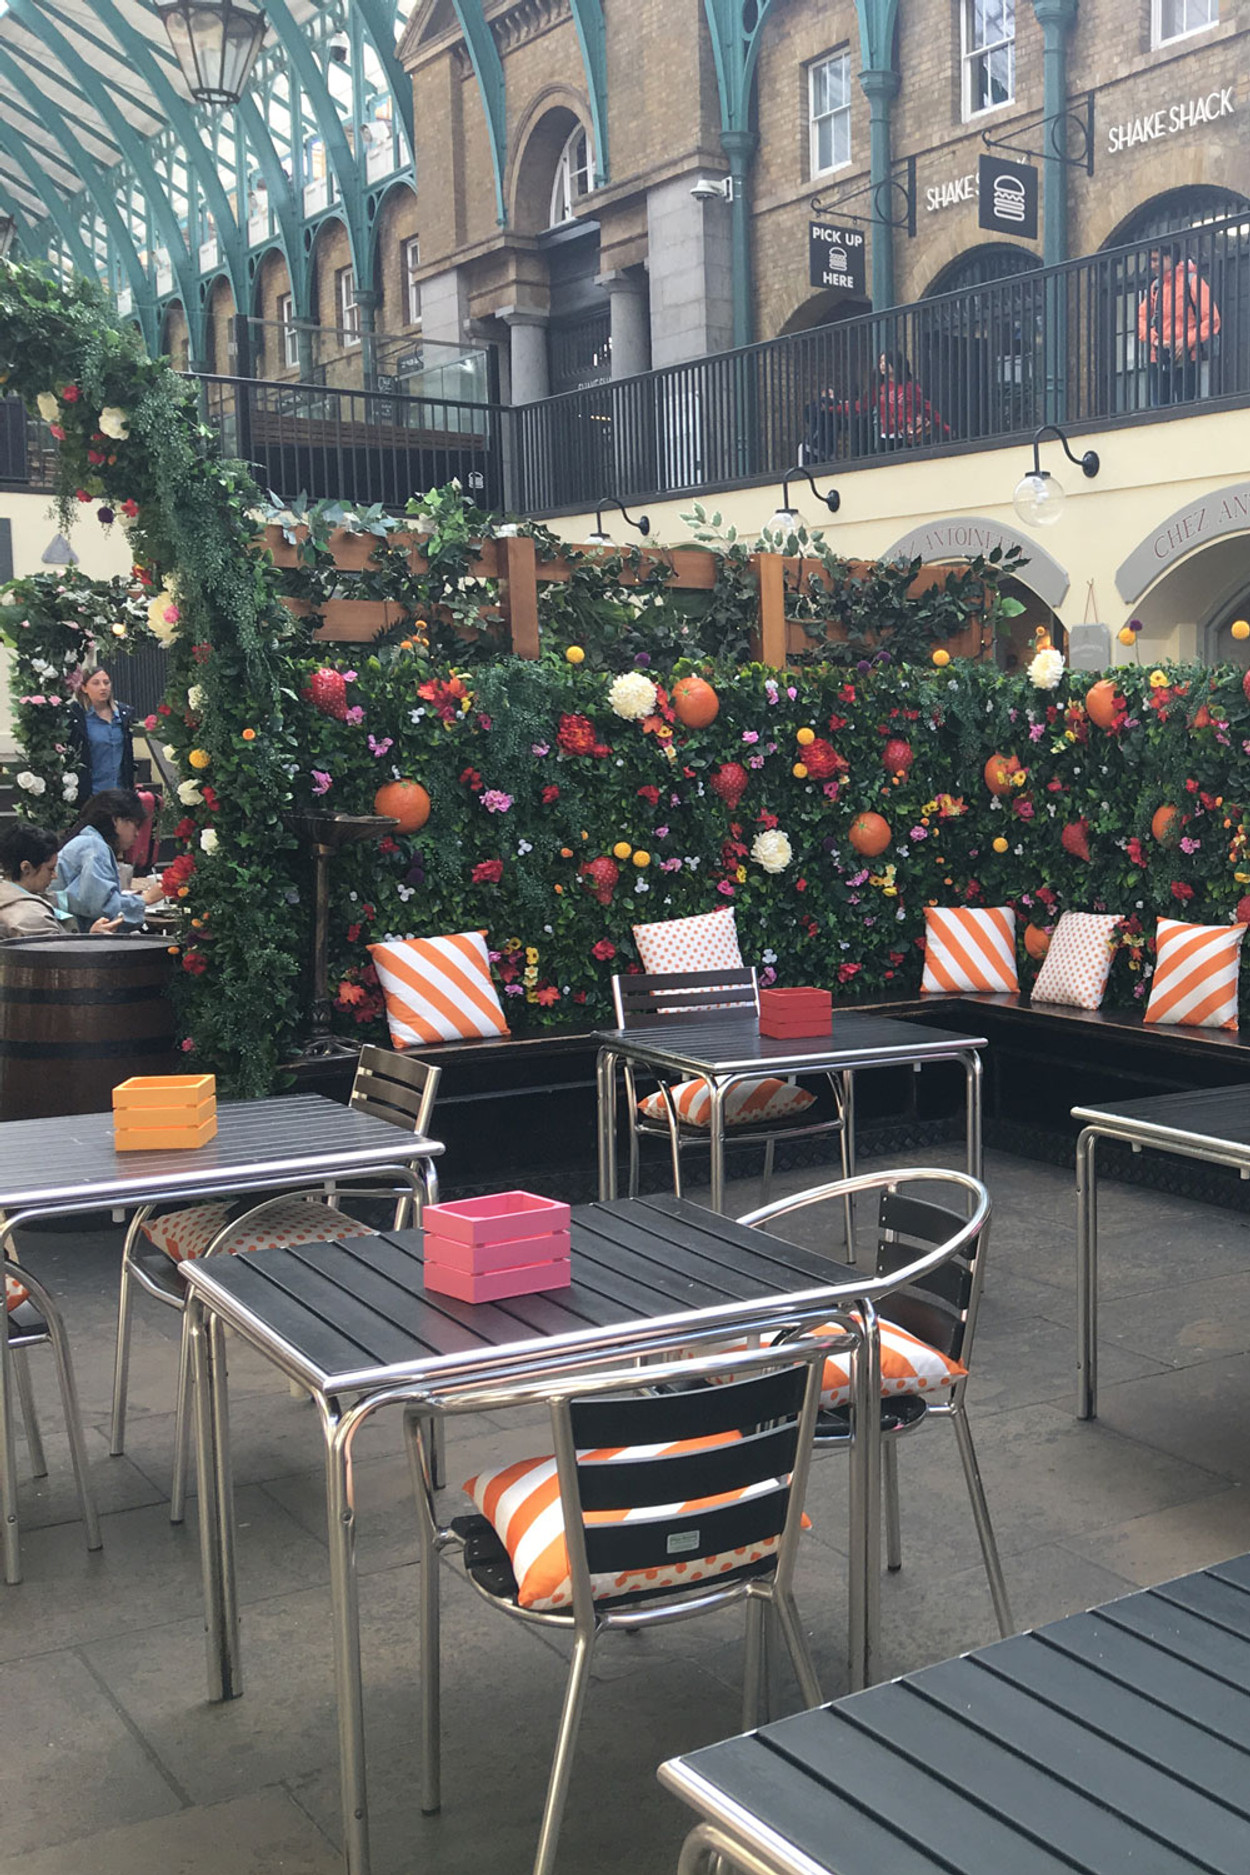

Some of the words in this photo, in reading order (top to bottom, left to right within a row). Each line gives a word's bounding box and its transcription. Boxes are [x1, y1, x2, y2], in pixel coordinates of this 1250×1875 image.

[1107, 109, 1167, 153] SHAKE
[1168, 85, 1235, 133] SHACK
[926, 174, 975, 212] SHAKE
[812, 226, 842, 244] PICK
[845, 232, 863, 247] UP
[822, 271, 854, 288] HERE
[1154, 508, 1209, 559] CHEZ
